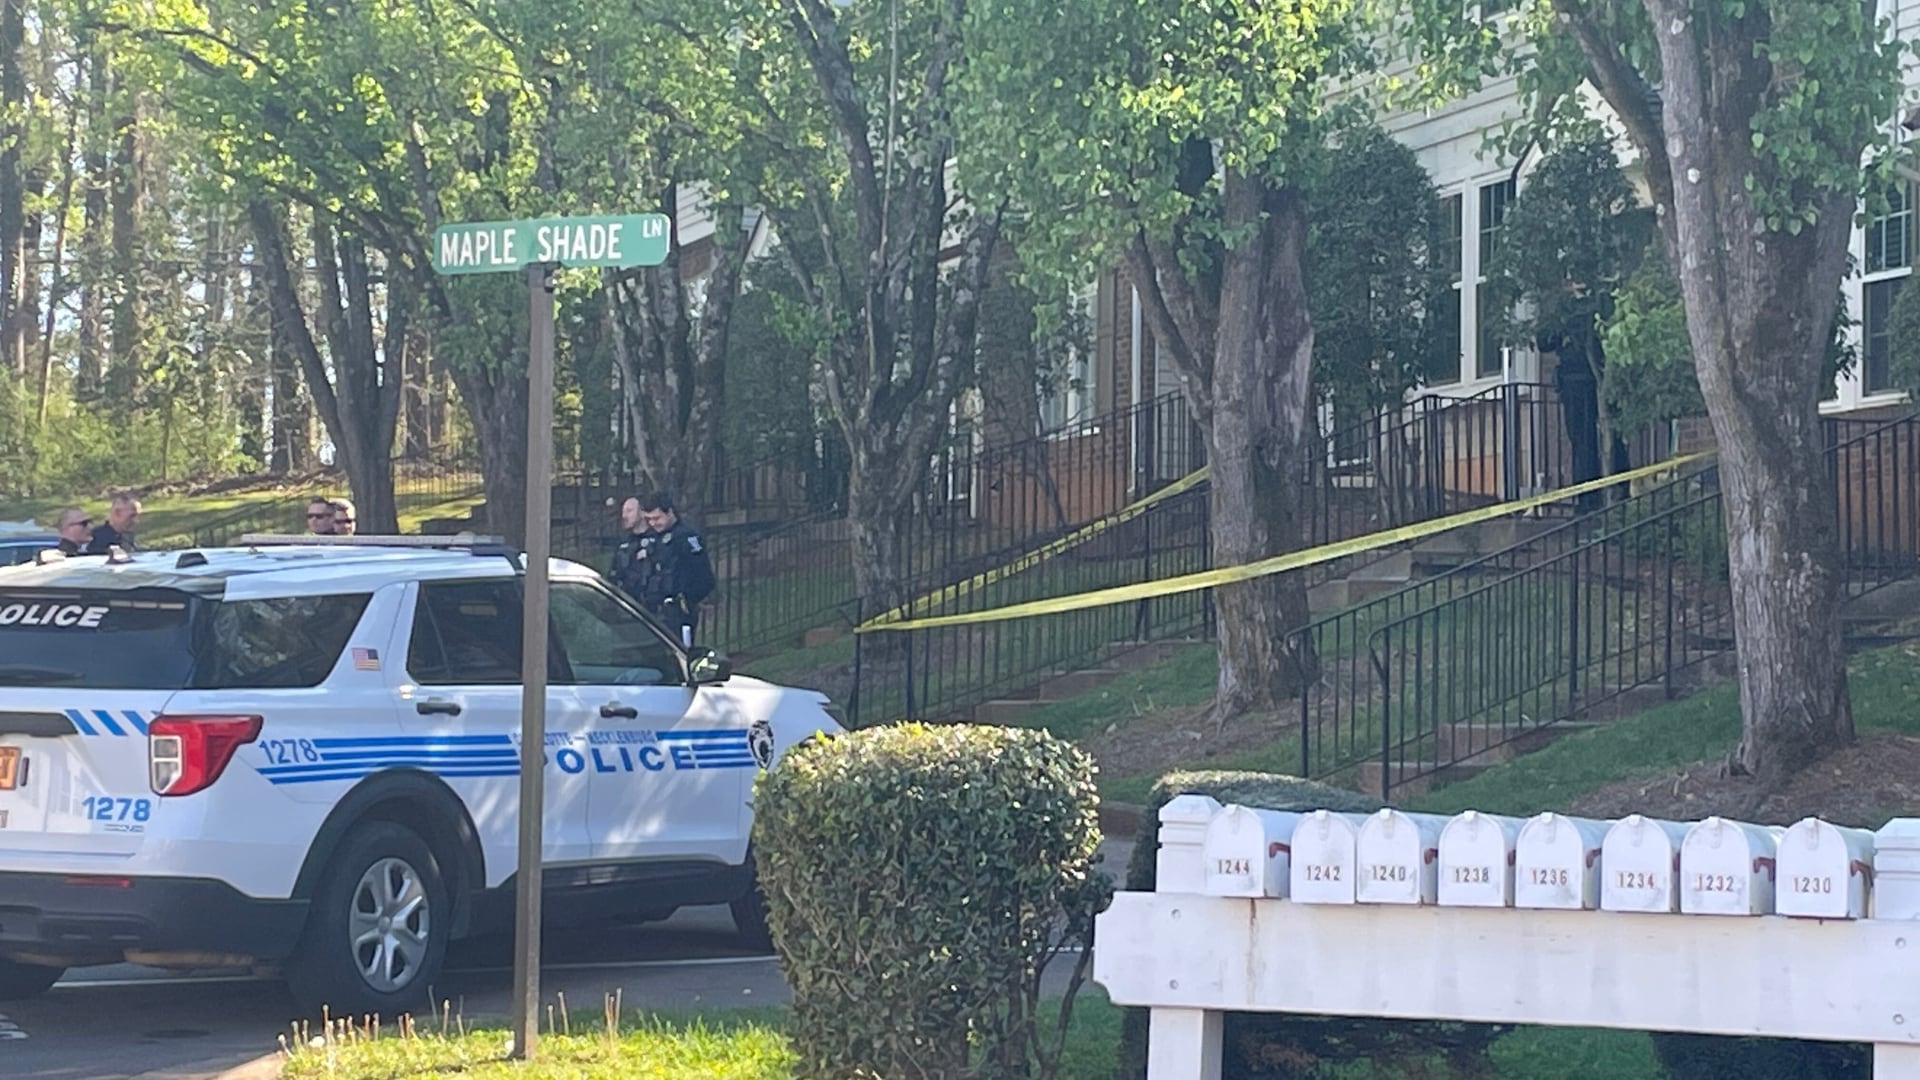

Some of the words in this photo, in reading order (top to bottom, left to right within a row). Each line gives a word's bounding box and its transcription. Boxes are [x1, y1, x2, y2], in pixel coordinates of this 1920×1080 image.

[441, 230, 518, 268] MAPLE
[538, 223, 623, 262] SHADE
[643, 219, 662, 238] LN
[0, 604, 110, 628] OLICE
[259, 738, 318, 764] 1278
[544, 746, 696, 774] OLICE
[82, 796, 151, 822] 1278
[1217, 859, 1250, 876] 1244
[1306, 865, 1341, 882] 1242
[1372, 865, 1407, 883] 1240
[1454, 867, 1490, 884] 1238
[1532, 868, 1568, 886] 1236
[1617, 872, 1655, 888] 1234
[1698, 874, 1735, 892] 1232
[1794, 877, 1832, 895] 1230
